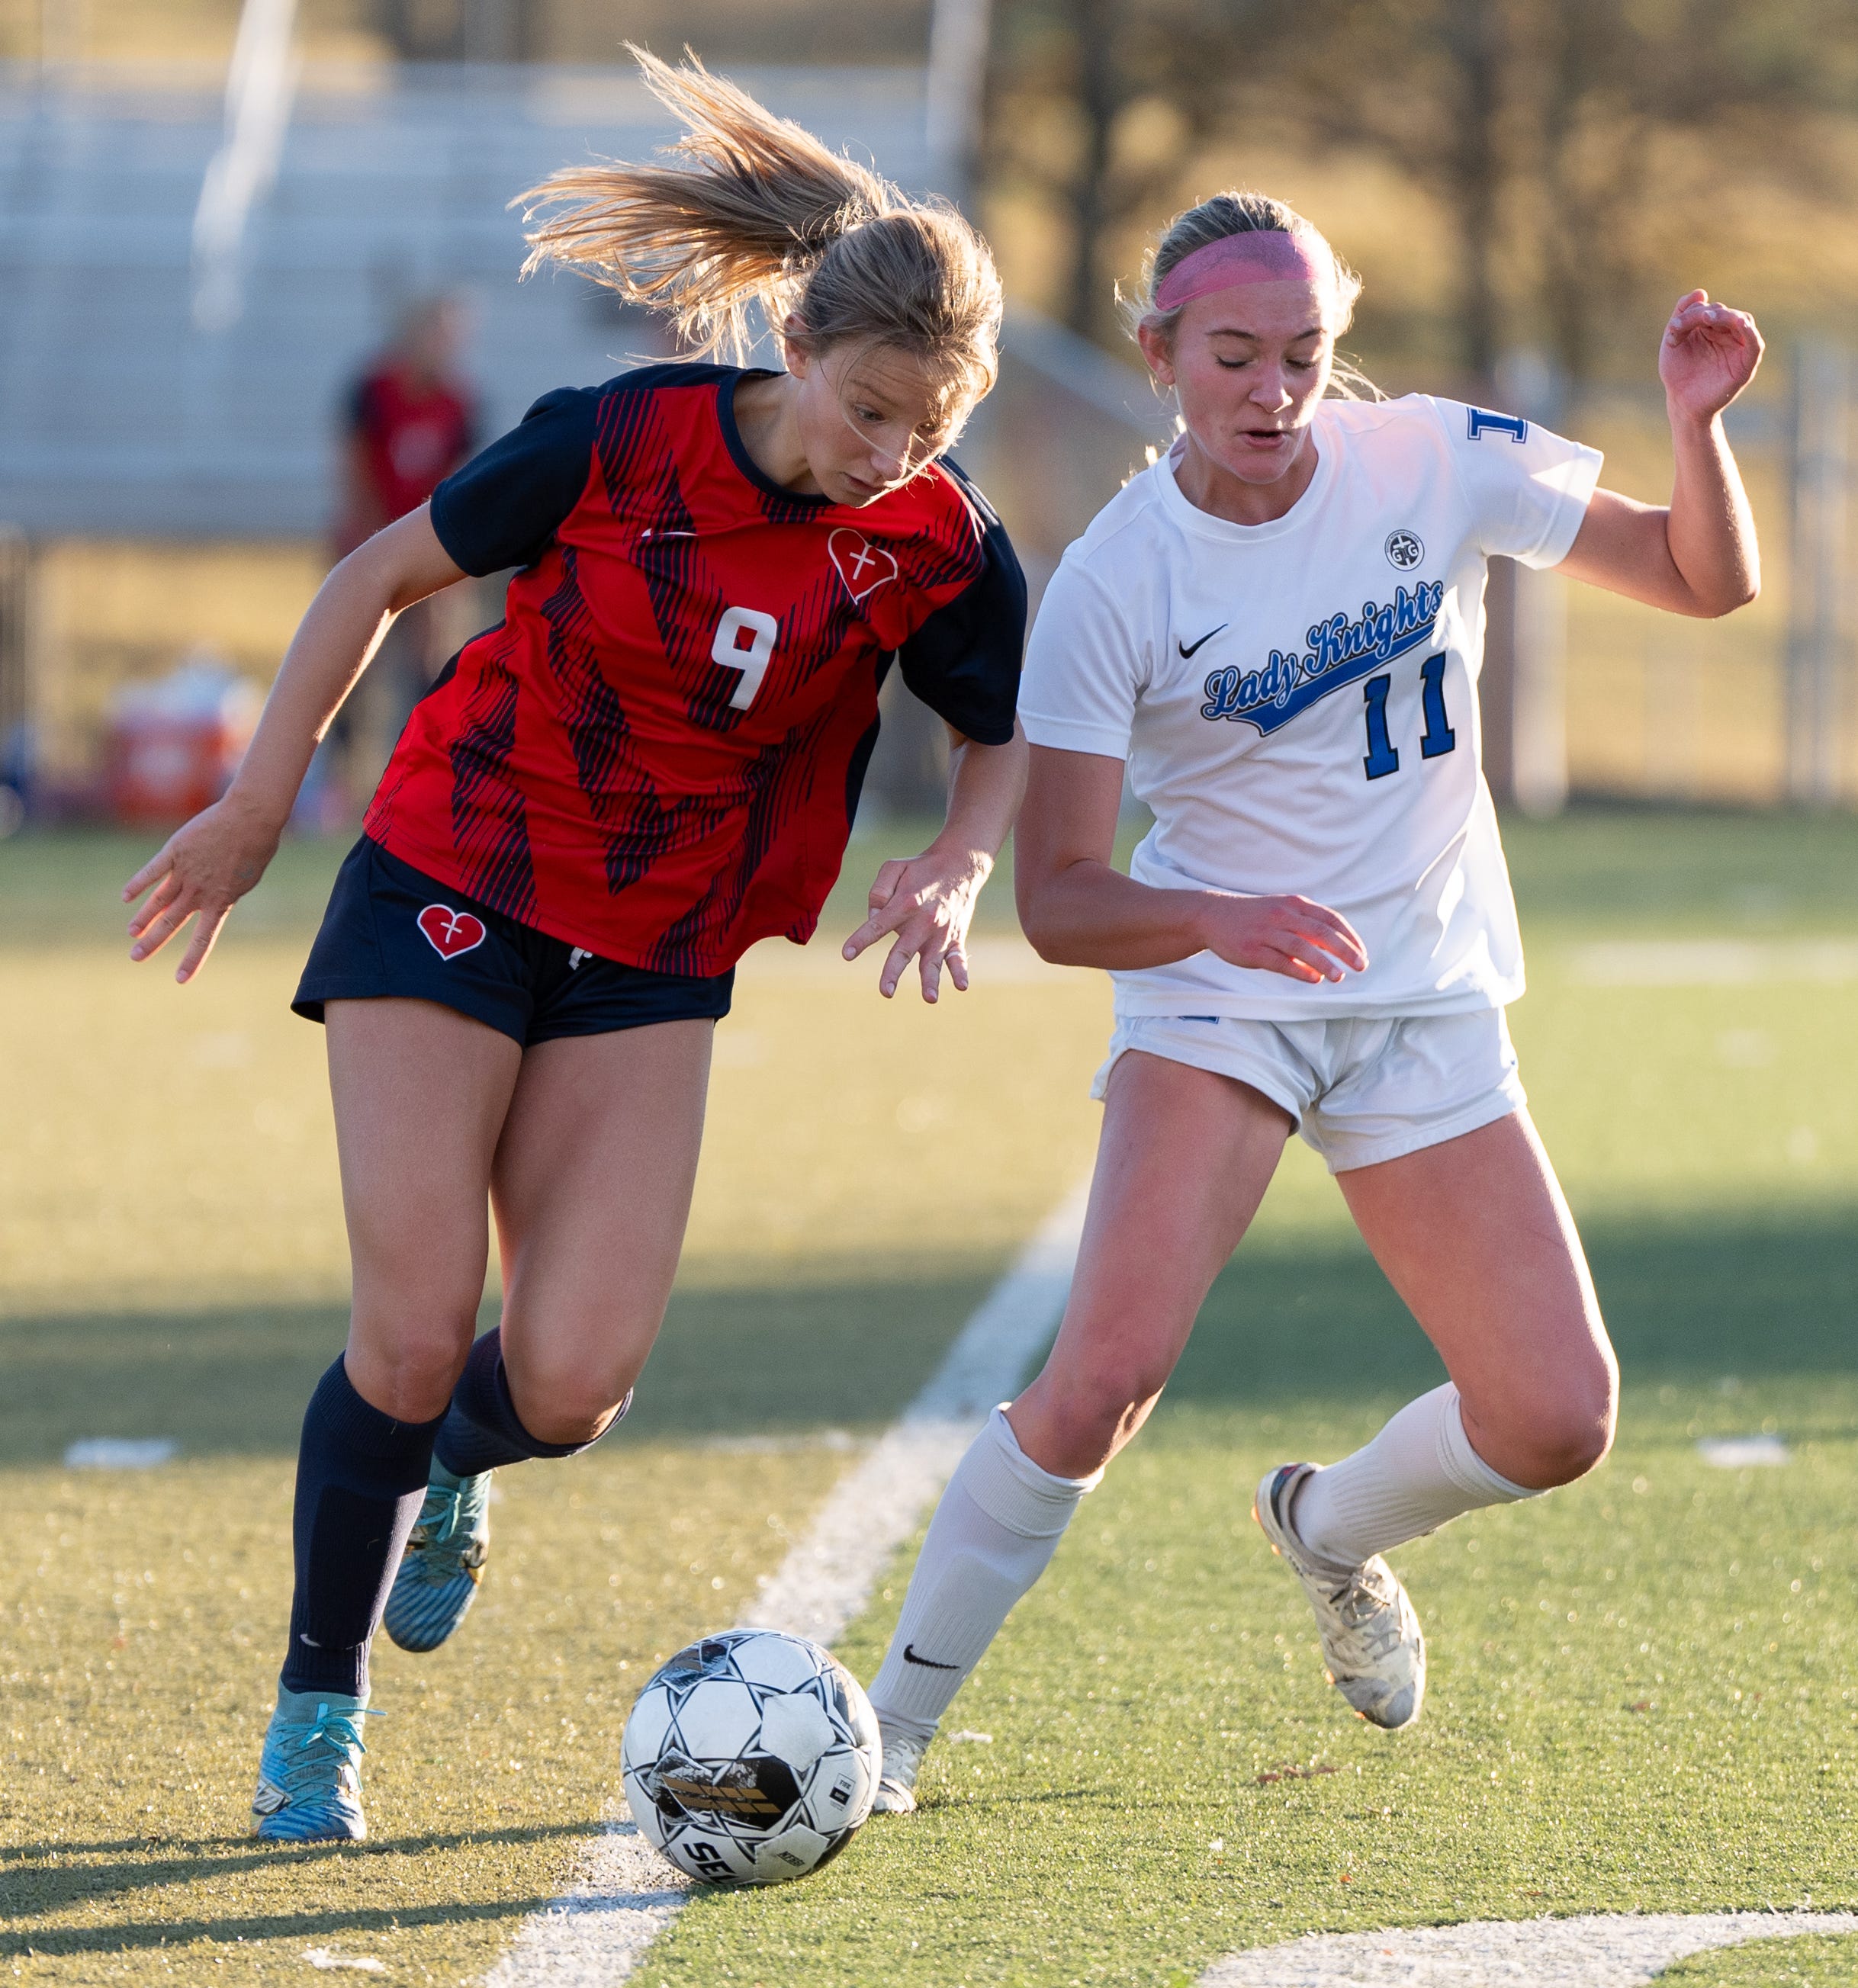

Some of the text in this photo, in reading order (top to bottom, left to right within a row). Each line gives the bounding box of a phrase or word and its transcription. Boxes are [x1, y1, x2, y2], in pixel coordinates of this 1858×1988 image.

[712, 606, 777, 711] 9
[1201, 580, 1444, 721] Lady Knights
[1363, 651, 1455, 781] 11
